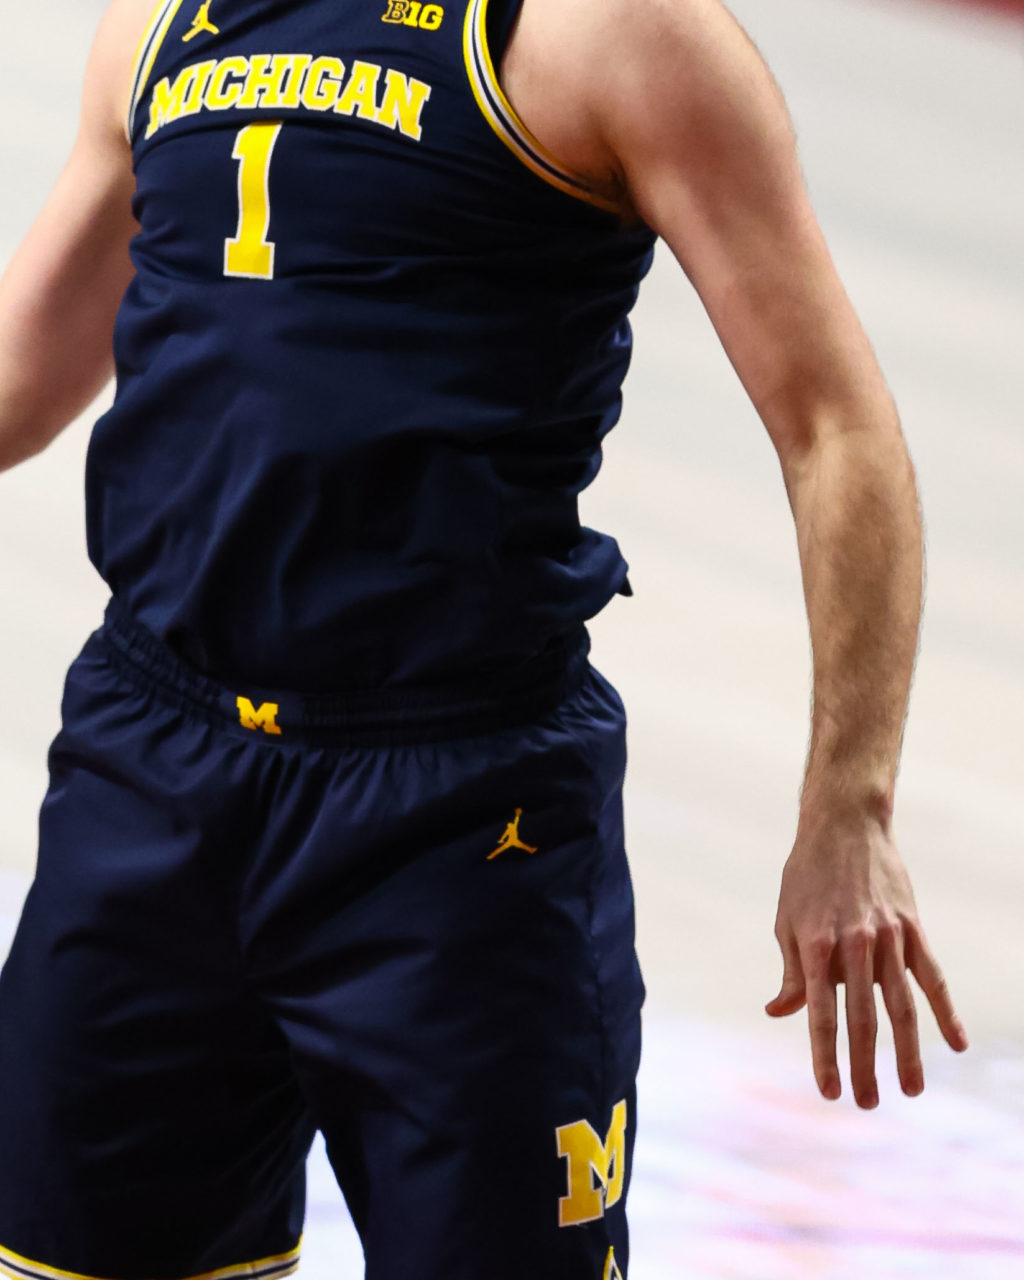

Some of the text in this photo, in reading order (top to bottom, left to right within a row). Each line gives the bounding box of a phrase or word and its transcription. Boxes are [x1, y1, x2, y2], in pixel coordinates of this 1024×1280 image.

[144, 54, 432, 142] MICHIGAN
[223, 120, 283, 280] 1
[236, 696, 282, 735] M
[555, 1098, 627, 1228] M
